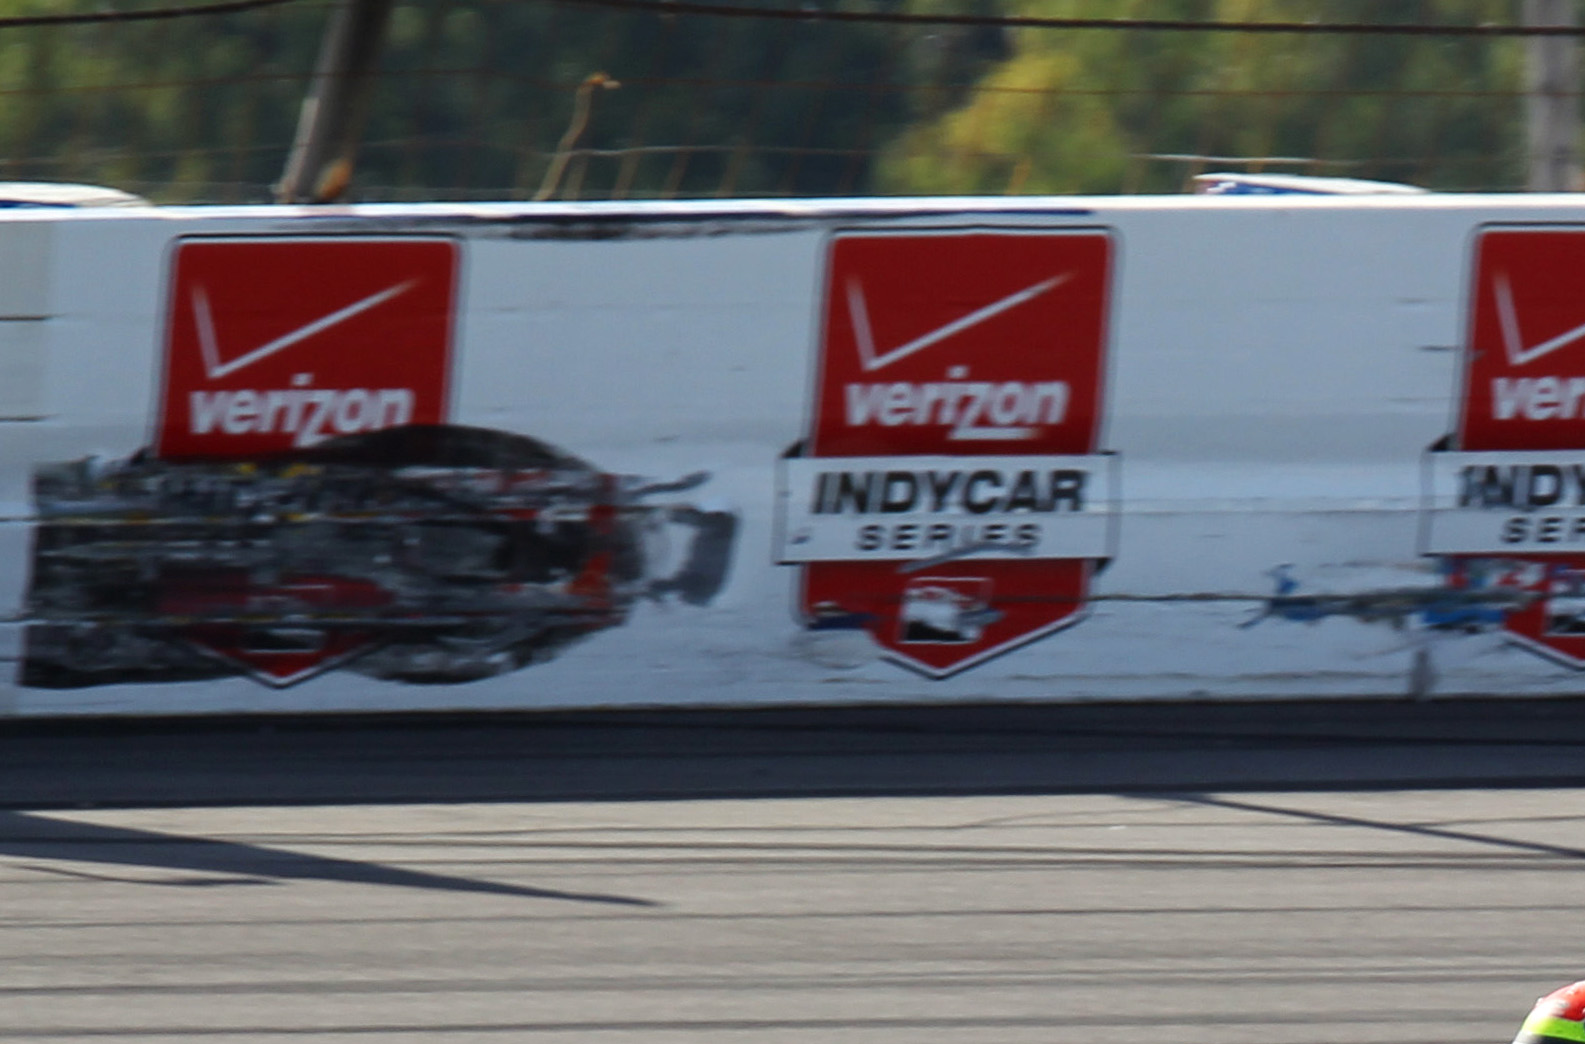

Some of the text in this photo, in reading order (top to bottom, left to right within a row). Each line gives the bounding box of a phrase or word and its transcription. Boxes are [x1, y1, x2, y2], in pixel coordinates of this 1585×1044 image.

[189, 372, 415, 447] verizon
[844, 365, 1070, 441] verizon
[811, 469, 1088, 515] INDYCAR
[854, 523, 1044, 552] SERIES
